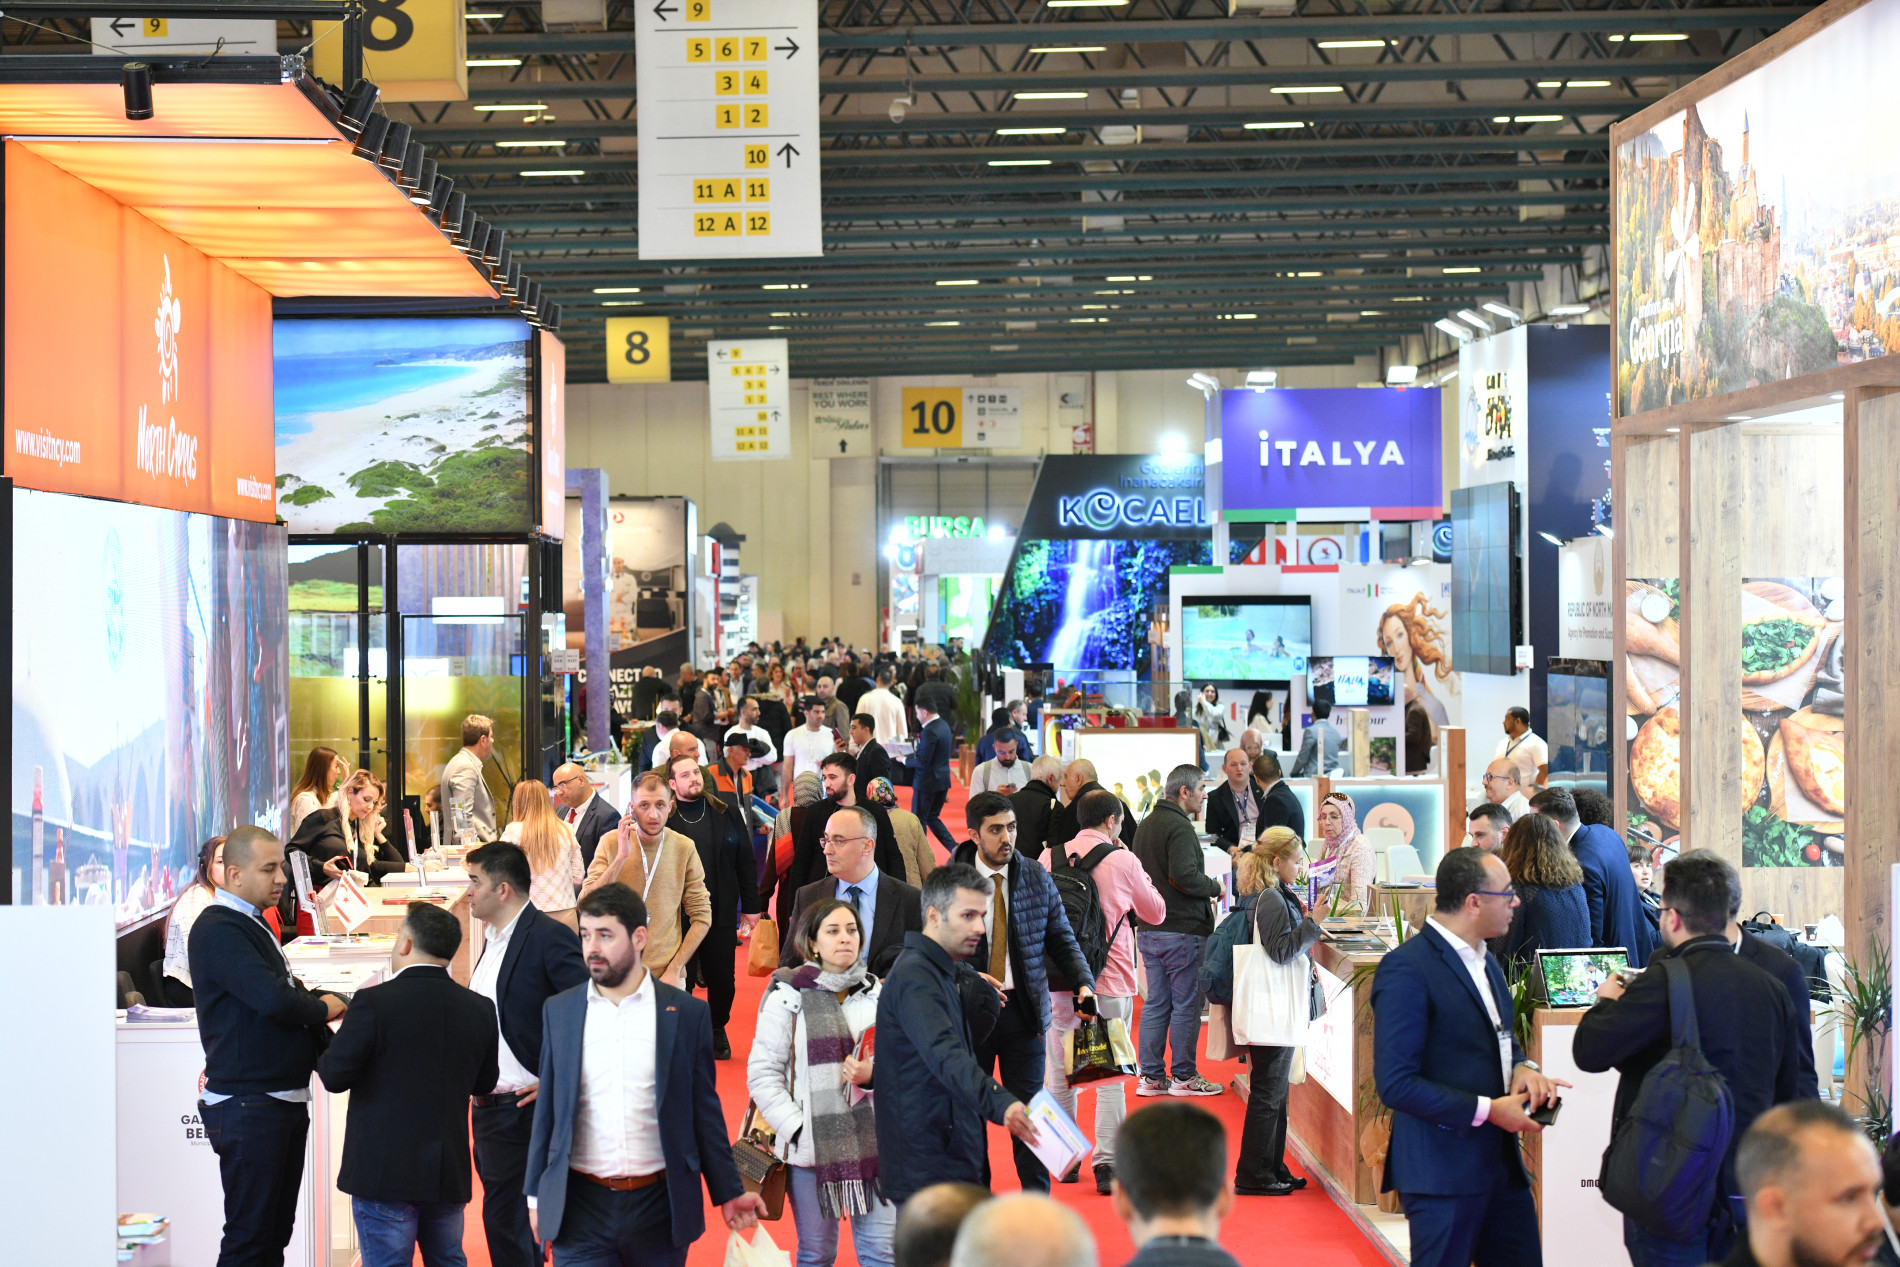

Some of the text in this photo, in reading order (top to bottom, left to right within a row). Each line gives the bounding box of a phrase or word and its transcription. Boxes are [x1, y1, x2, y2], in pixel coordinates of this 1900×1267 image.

[693, 3, 703, 17] 9
[150, 18, 160, 32] 9
[694, 42, 760, 57] 5 6 7
[723, 75, 760, 90] 3 4
[724, 109, 761, 124] 1 2
[748, 150, 766, 164] 10
[697, 183, 766, 198] 11 A 11
[697, 216, 766, 232] 12 A 12
[625, 331, 650, 365] 8
[1629, 316, 1683, 369] Georgia
[814, 400, 868, 408] YOU WORK
[757, 413, 767, 421] 10
[911, 401, 956, 434] 10
[736, 428, 745, 436] 11
[758, 427, 767, 435] 11
[15, 428, 81, 467] www.visitncy.com
[237, 475, 272, 503] www.visitncy.com
[904, 516, 987, 539] BURSA
[1593, 602, 1607, 617] NORTH
[577, 667, 641, 683] CNECT
